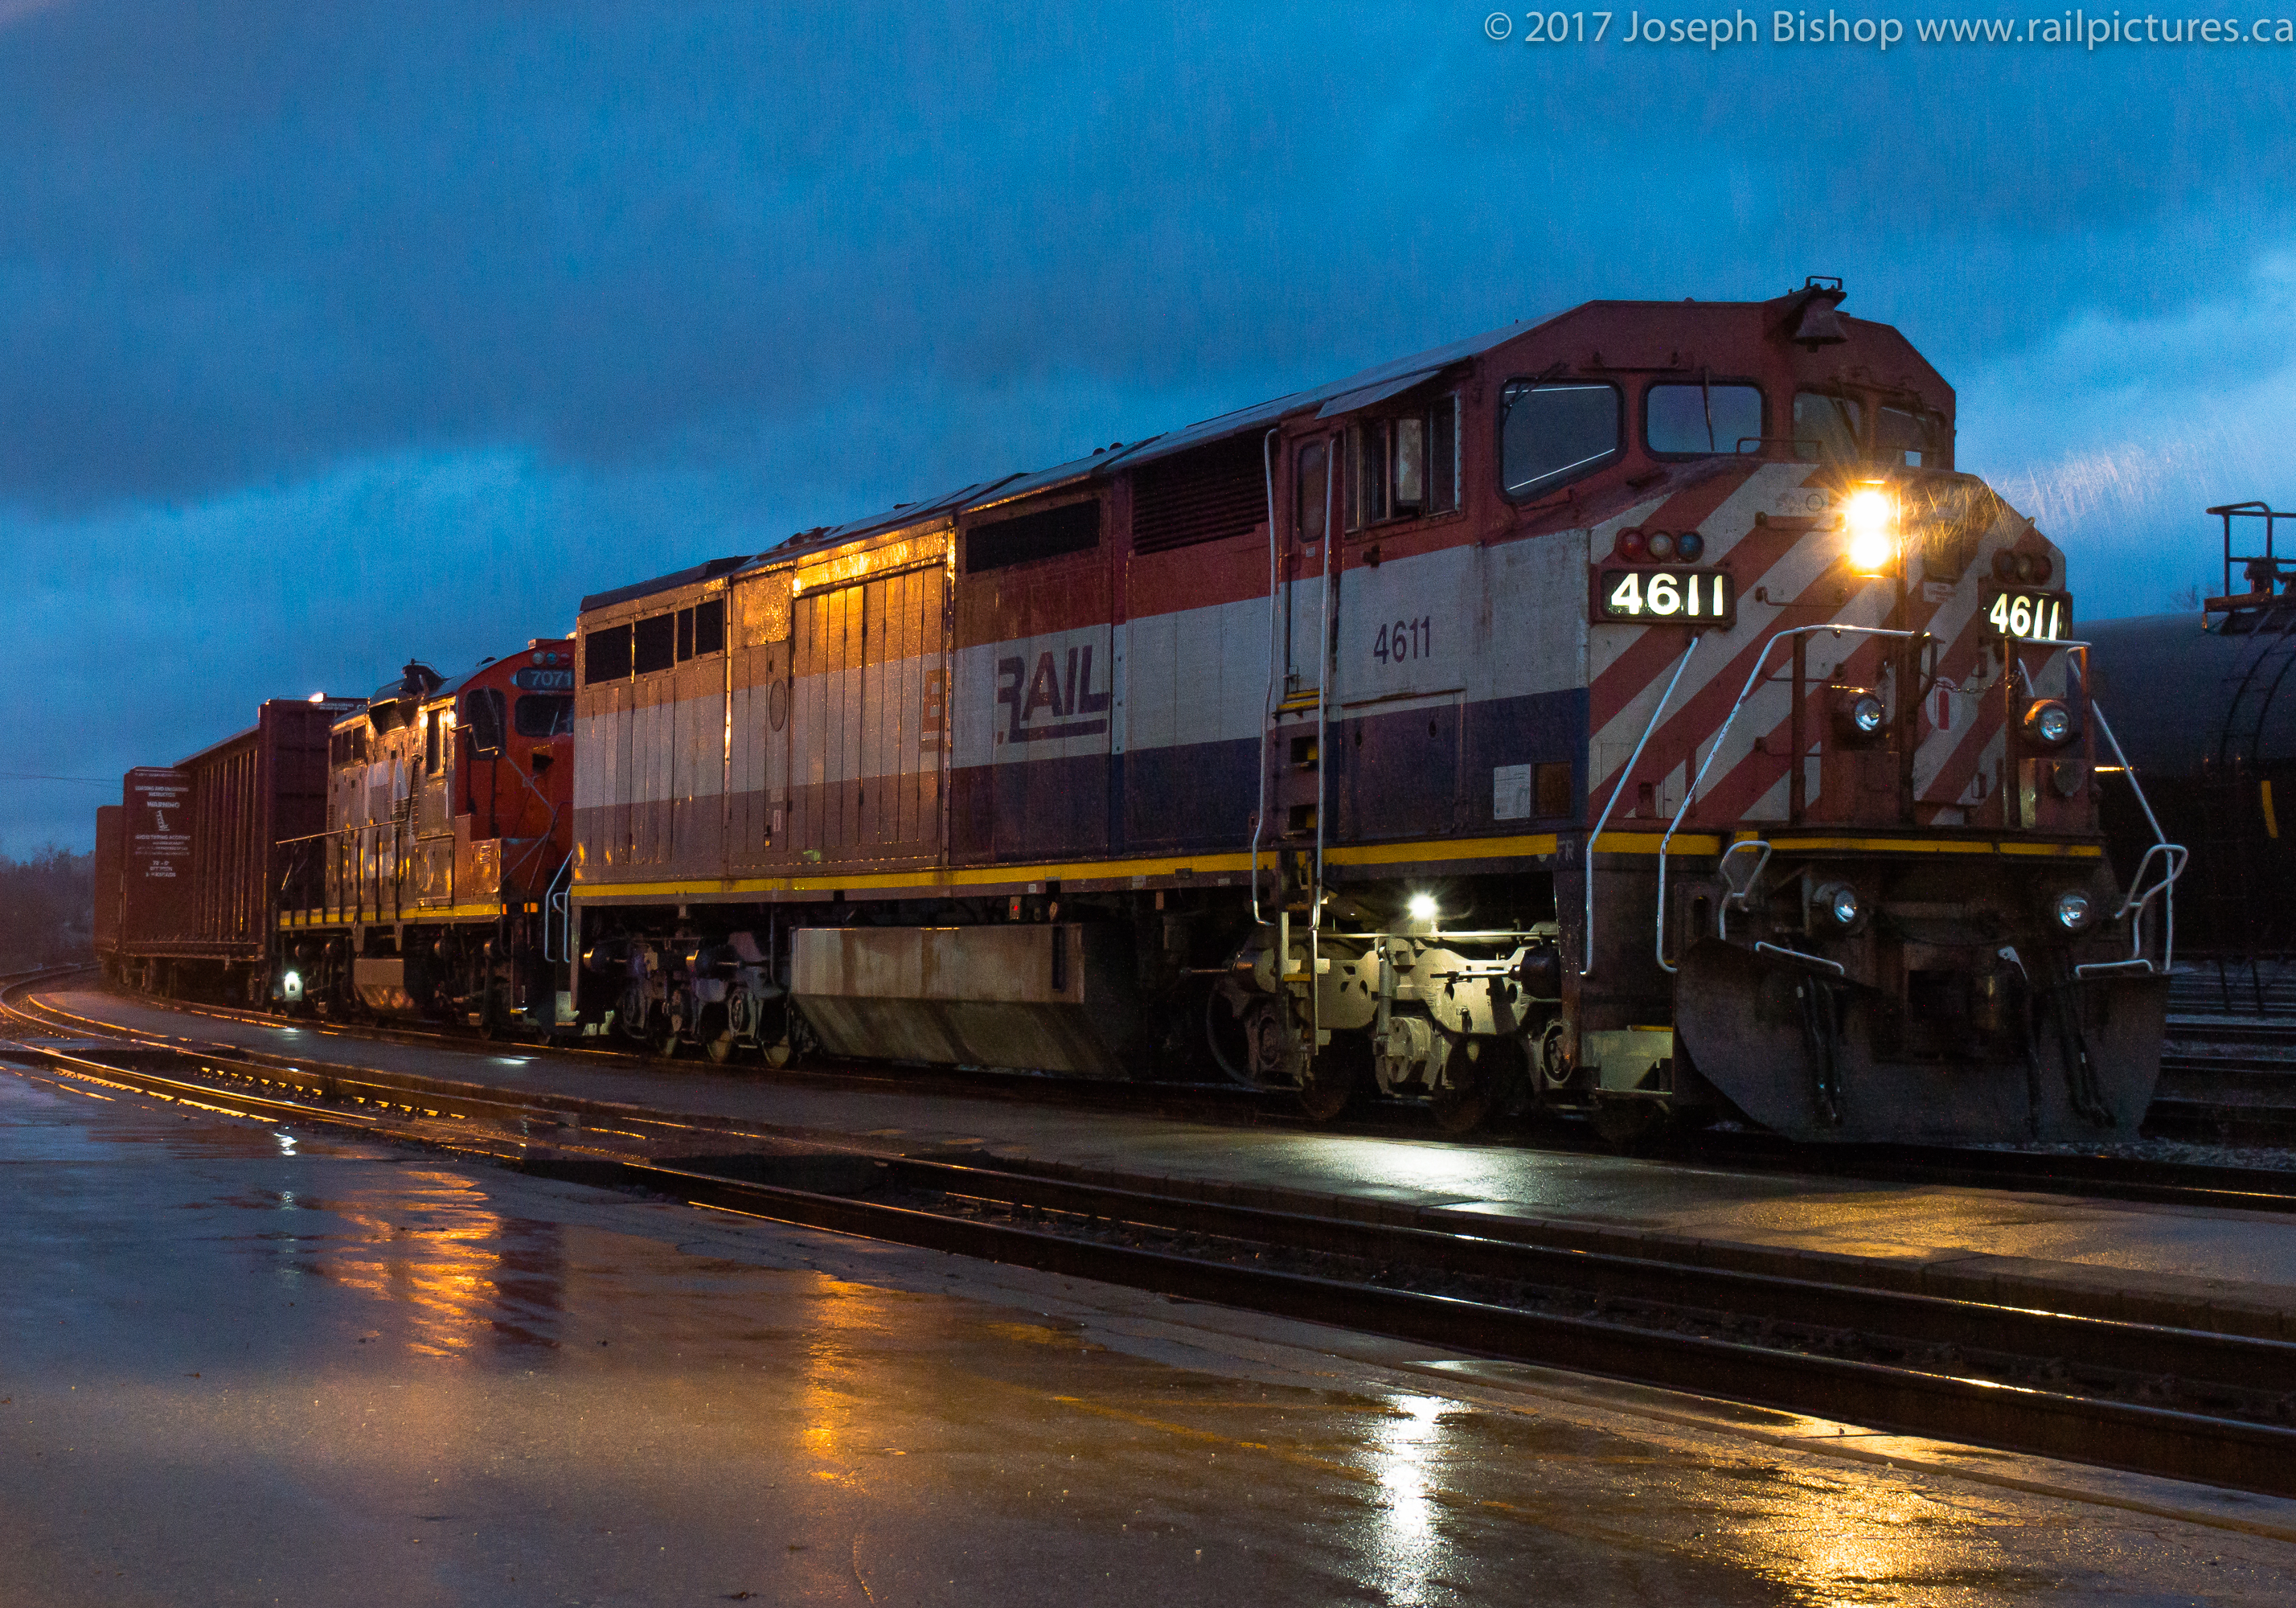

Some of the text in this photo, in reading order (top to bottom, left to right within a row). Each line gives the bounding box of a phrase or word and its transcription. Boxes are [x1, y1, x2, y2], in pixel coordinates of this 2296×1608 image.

[1611, 572, 1724, 617] 4611
[1990, 593, 2060, 641] 4611
[1373, 616, 1430, 665] 4611
[531, 671, 572, 687] 7071
